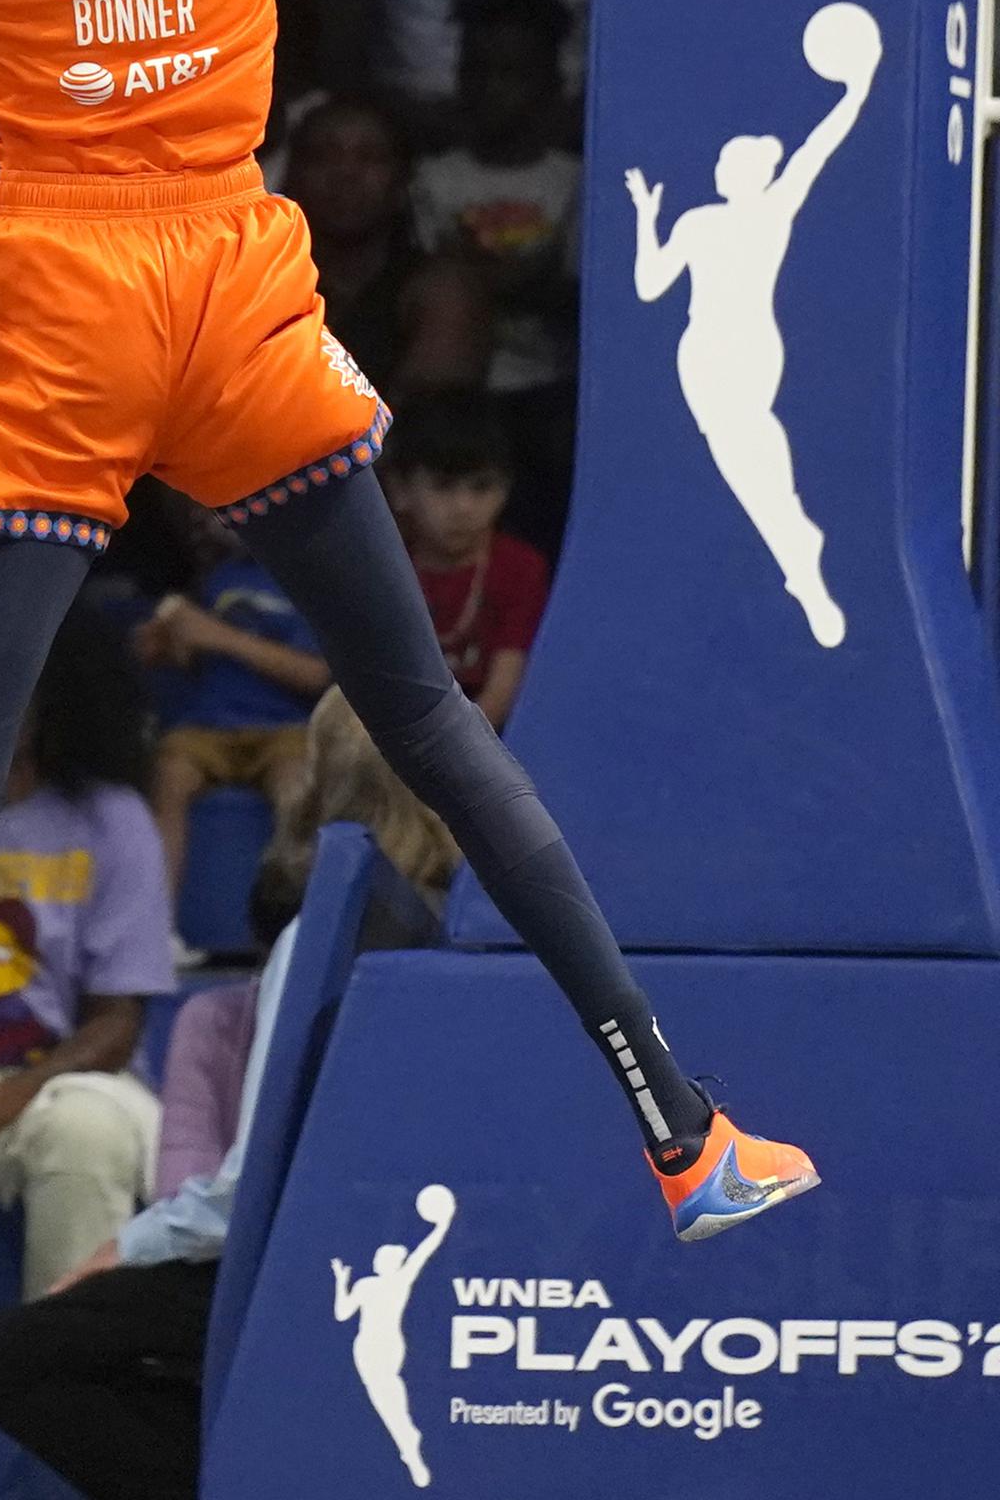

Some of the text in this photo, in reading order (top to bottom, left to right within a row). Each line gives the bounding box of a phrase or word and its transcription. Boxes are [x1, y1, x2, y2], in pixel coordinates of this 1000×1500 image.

[124, 47, 220, 97] AT&T
[452, 1278, 613, 1308] WNBA
[450, 1382, 762, 1440] Presented by Google
